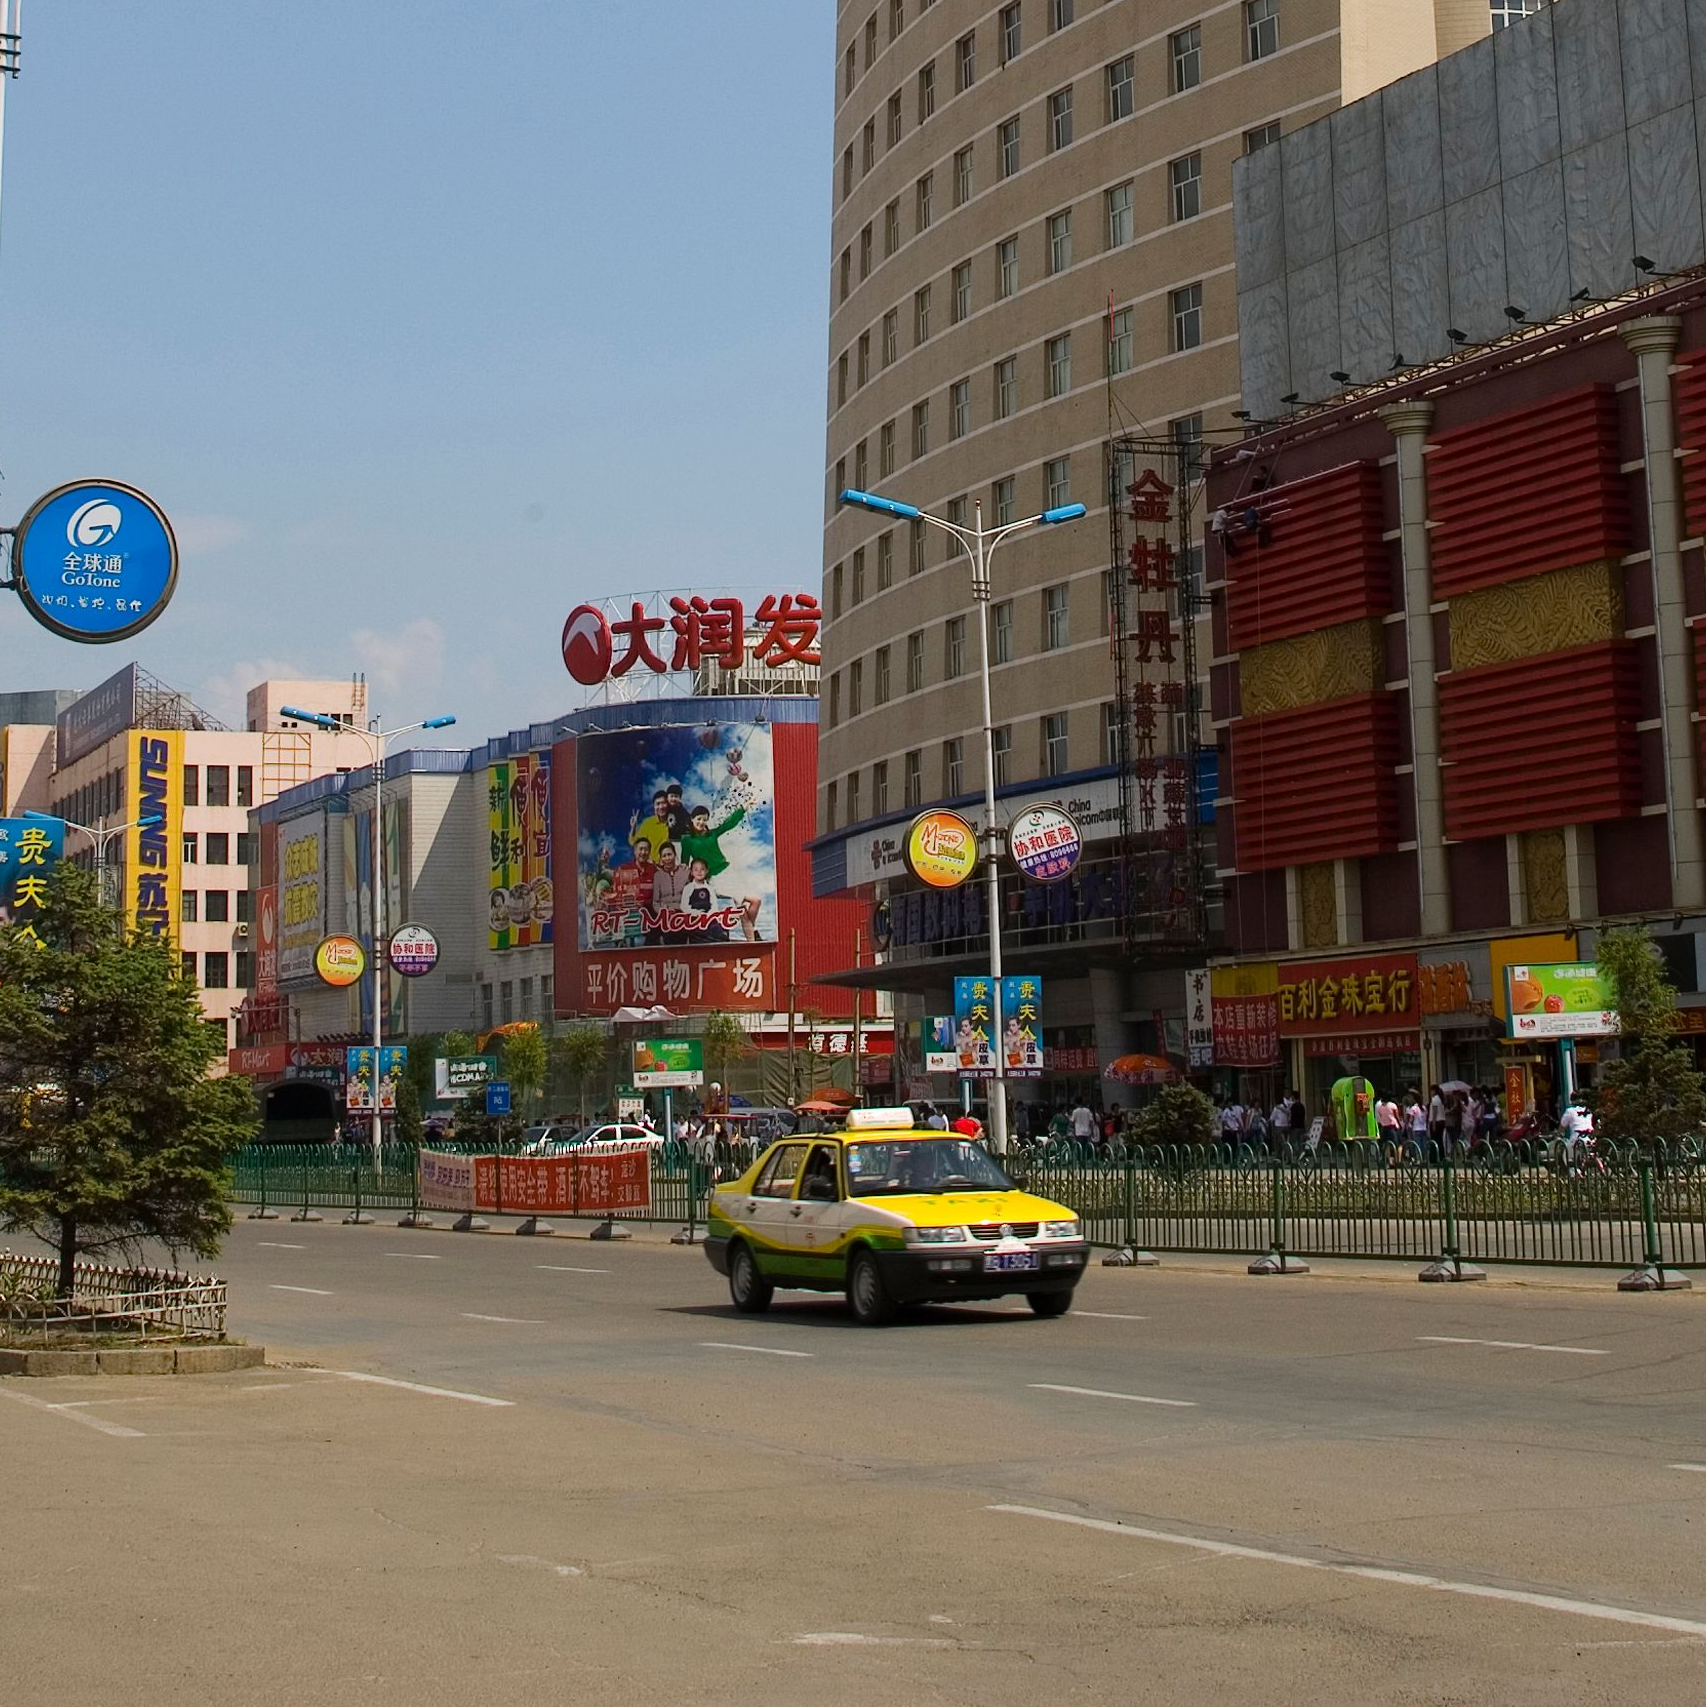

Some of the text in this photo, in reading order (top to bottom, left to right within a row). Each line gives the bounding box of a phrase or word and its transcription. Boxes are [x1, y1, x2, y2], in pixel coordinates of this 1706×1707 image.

[61, 571, 121, 588] GoTone
[63, 551, 122, 573] 全球通
[611, 594, 821, 674] 大润发
[139, 736, 168, 870] SUNING
[1014, 825, 1074, 857] 协和医院
[13, 827, 53, 950] 贵夫人
[135, 872, 169, 943] 苏宁
[591, 906, 746, 935] RT-Mart
[587, 957, 763, 1004] 平价购物广场
[1193, 974, 1207, 1023] 书店
[1280, 969, 1412, 1021] 百利金珠宝行
[971, 981, 990, 1042] 贵夫人
[1018, 981, 1037, 1041] 贵夫人
[1213, 1001, 1277, 1030] 本店重新装修
[808, 1032, 869, 1053] 肯德基
